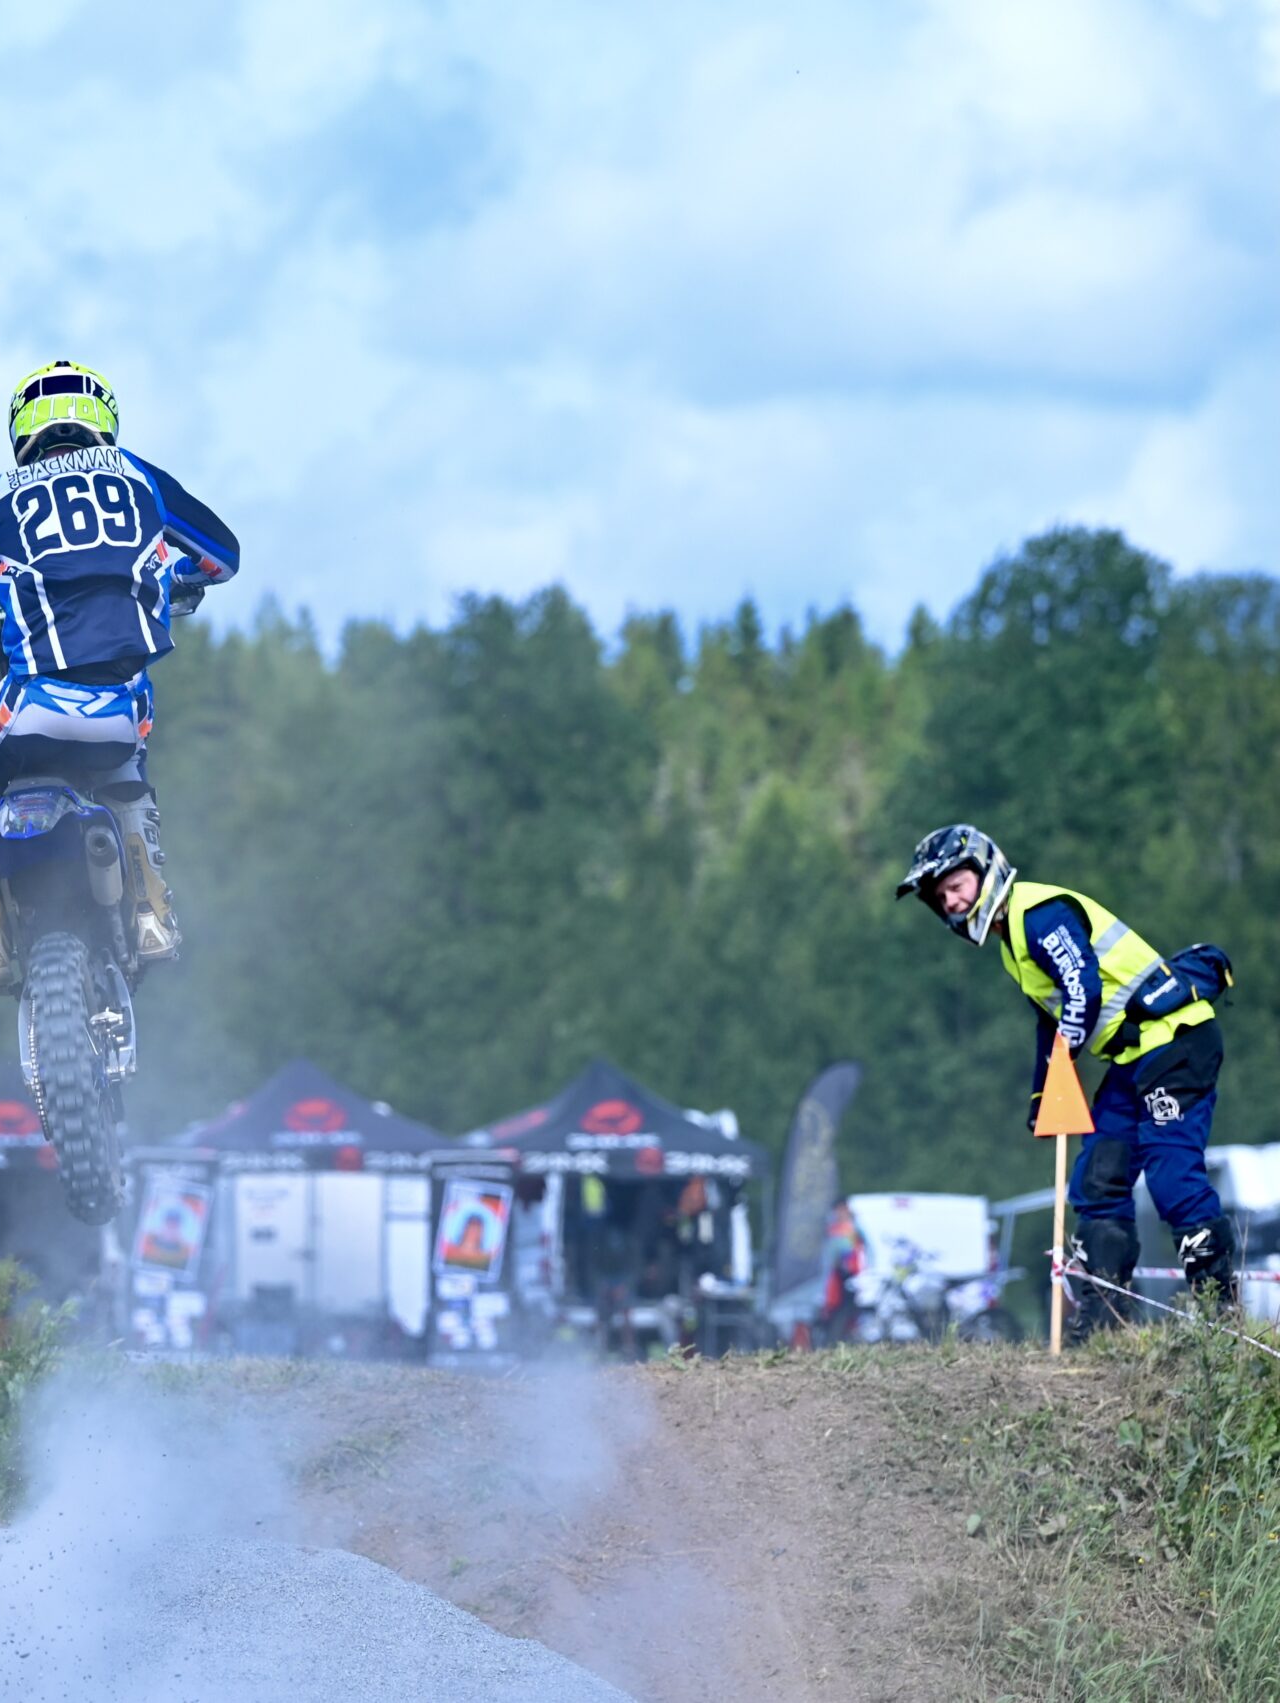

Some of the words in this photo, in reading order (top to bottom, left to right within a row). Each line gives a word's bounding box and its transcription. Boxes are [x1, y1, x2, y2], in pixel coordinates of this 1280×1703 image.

[17, 447, 125, 486] BACKMAN
[13, 472, 140, 562] 269
[1042, 932, 1087, 1024] Husqvarna
